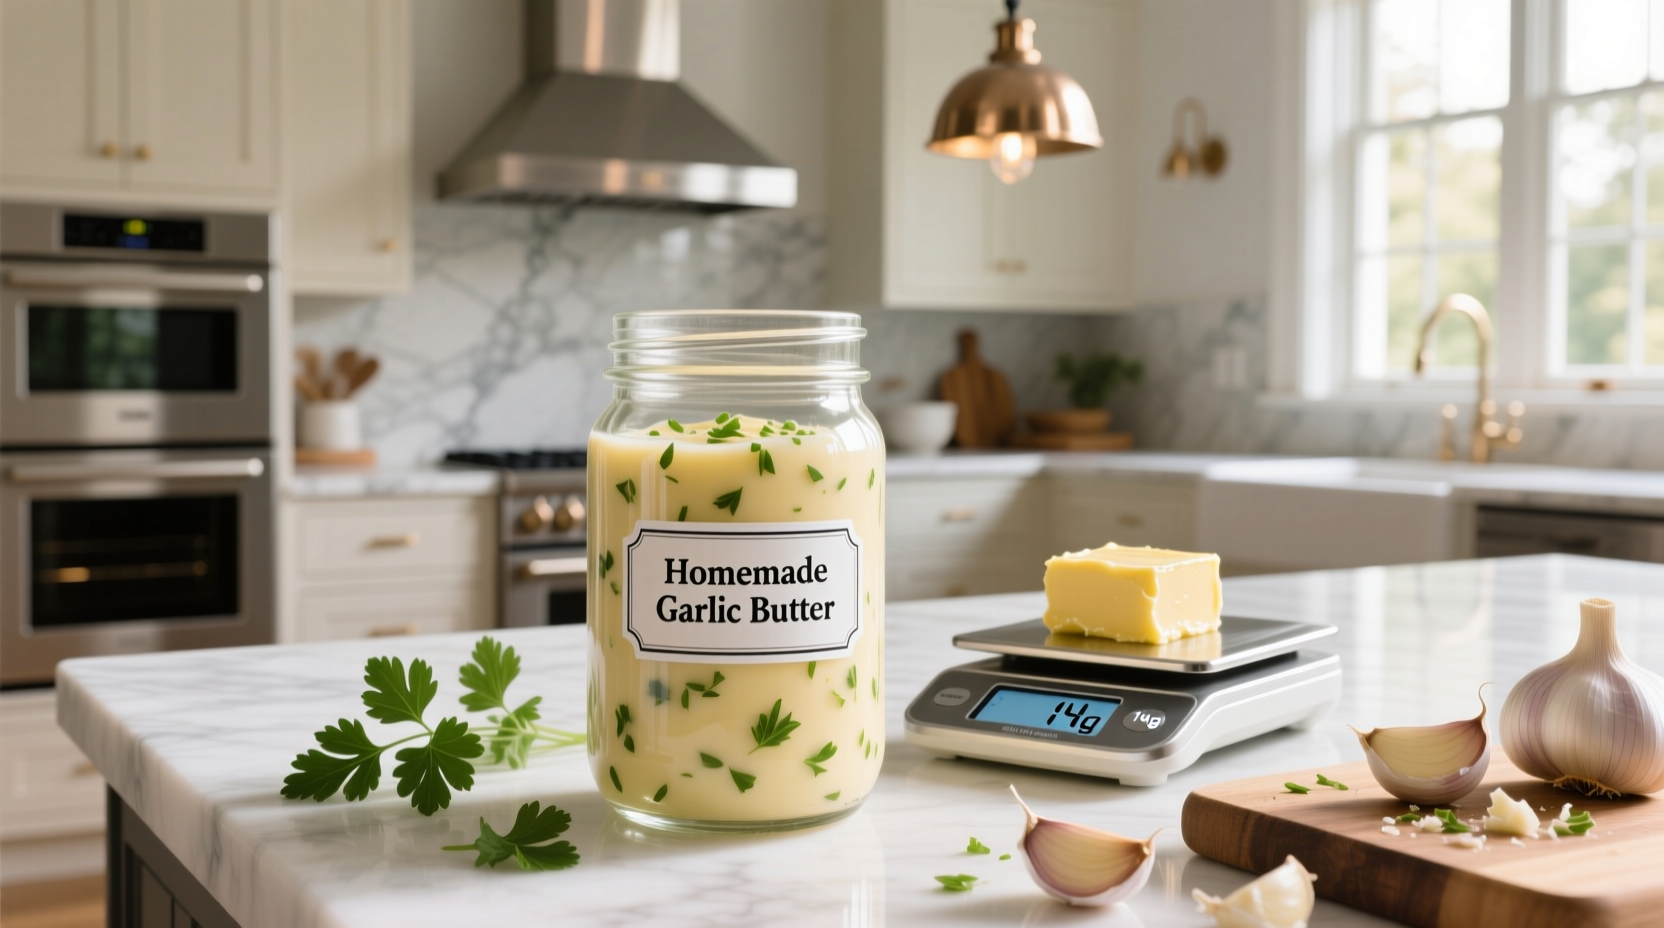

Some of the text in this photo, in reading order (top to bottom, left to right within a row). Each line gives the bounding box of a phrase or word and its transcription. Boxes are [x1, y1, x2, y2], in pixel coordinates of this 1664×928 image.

[664, 555, 828, 585] Homemade
[656, 595, 836, 624] Garlic Butter
[1046, 701, 1102, 734] 14g
